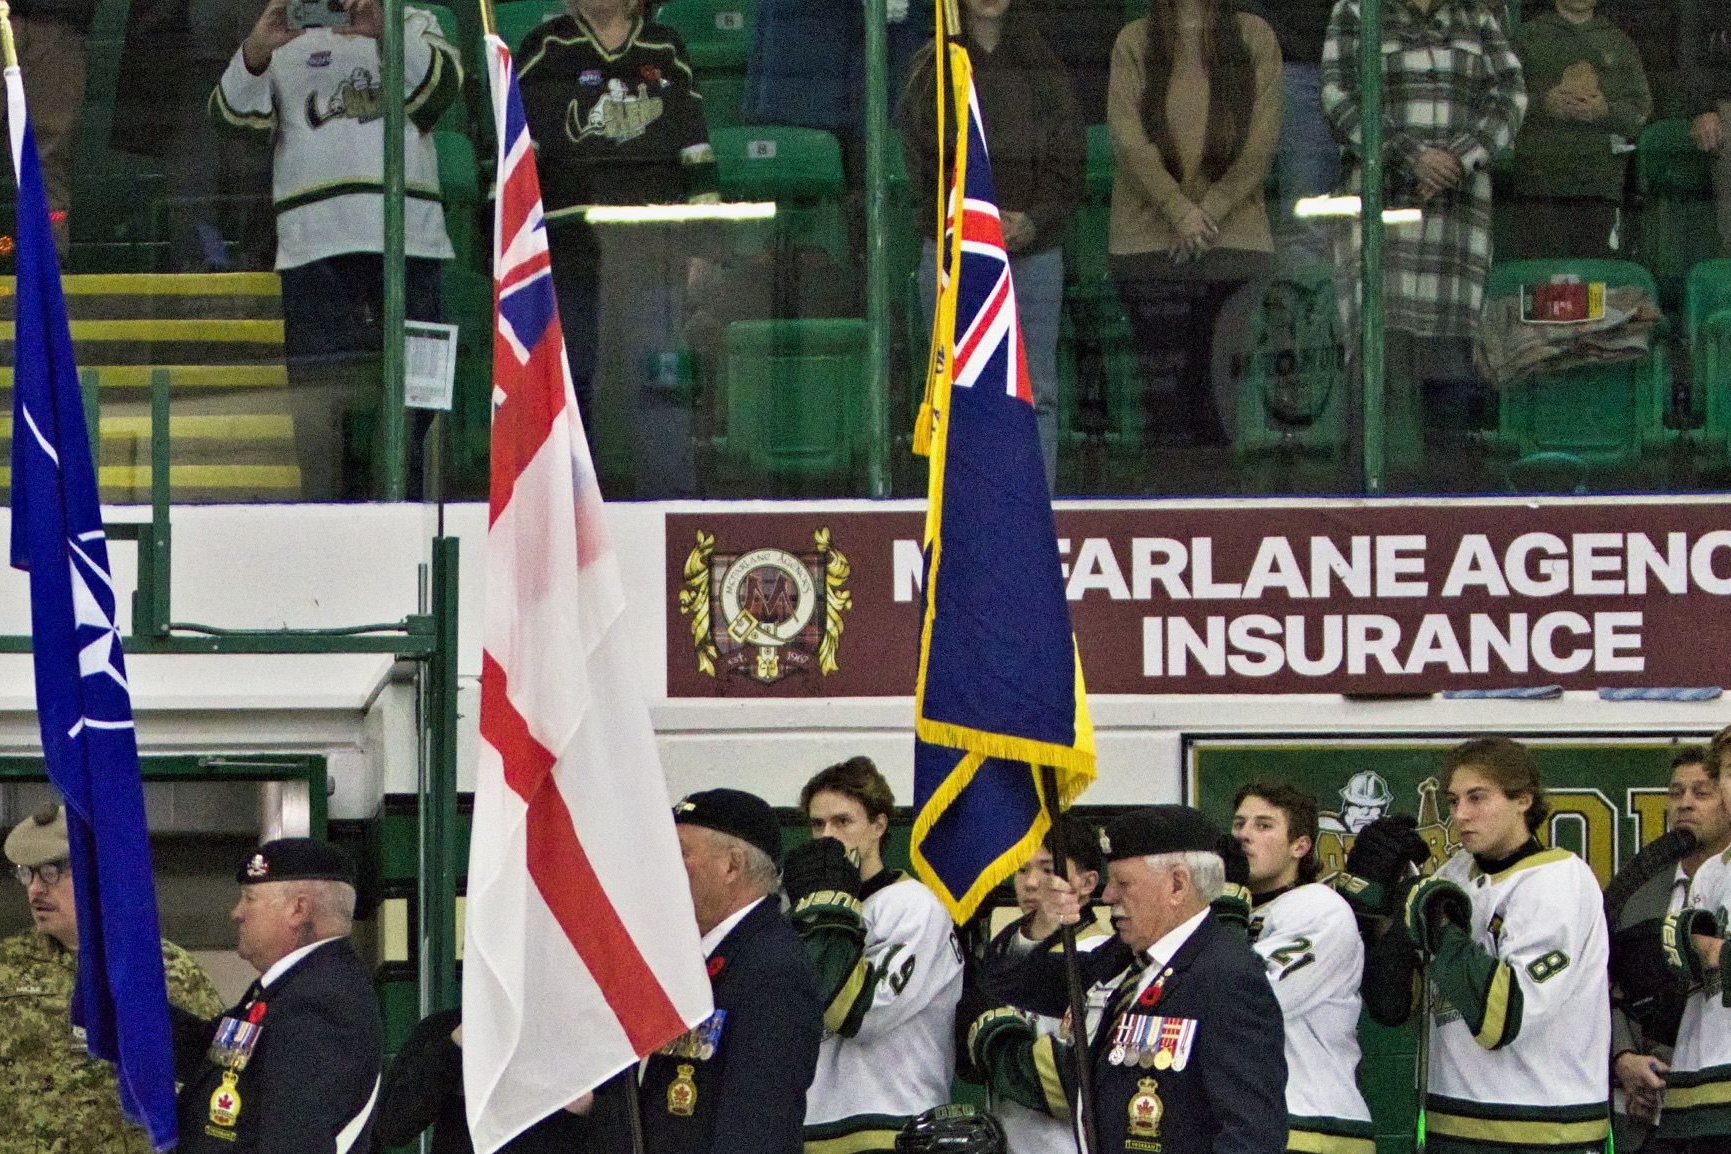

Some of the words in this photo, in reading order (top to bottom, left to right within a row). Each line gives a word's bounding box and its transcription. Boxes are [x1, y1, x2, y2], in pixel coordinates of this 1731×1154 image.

[894, 534, 1429, 602] ARLANE
[1142, 610, 1645, 678] INSURANCE
[1525, 949, 1570, 984] 8
